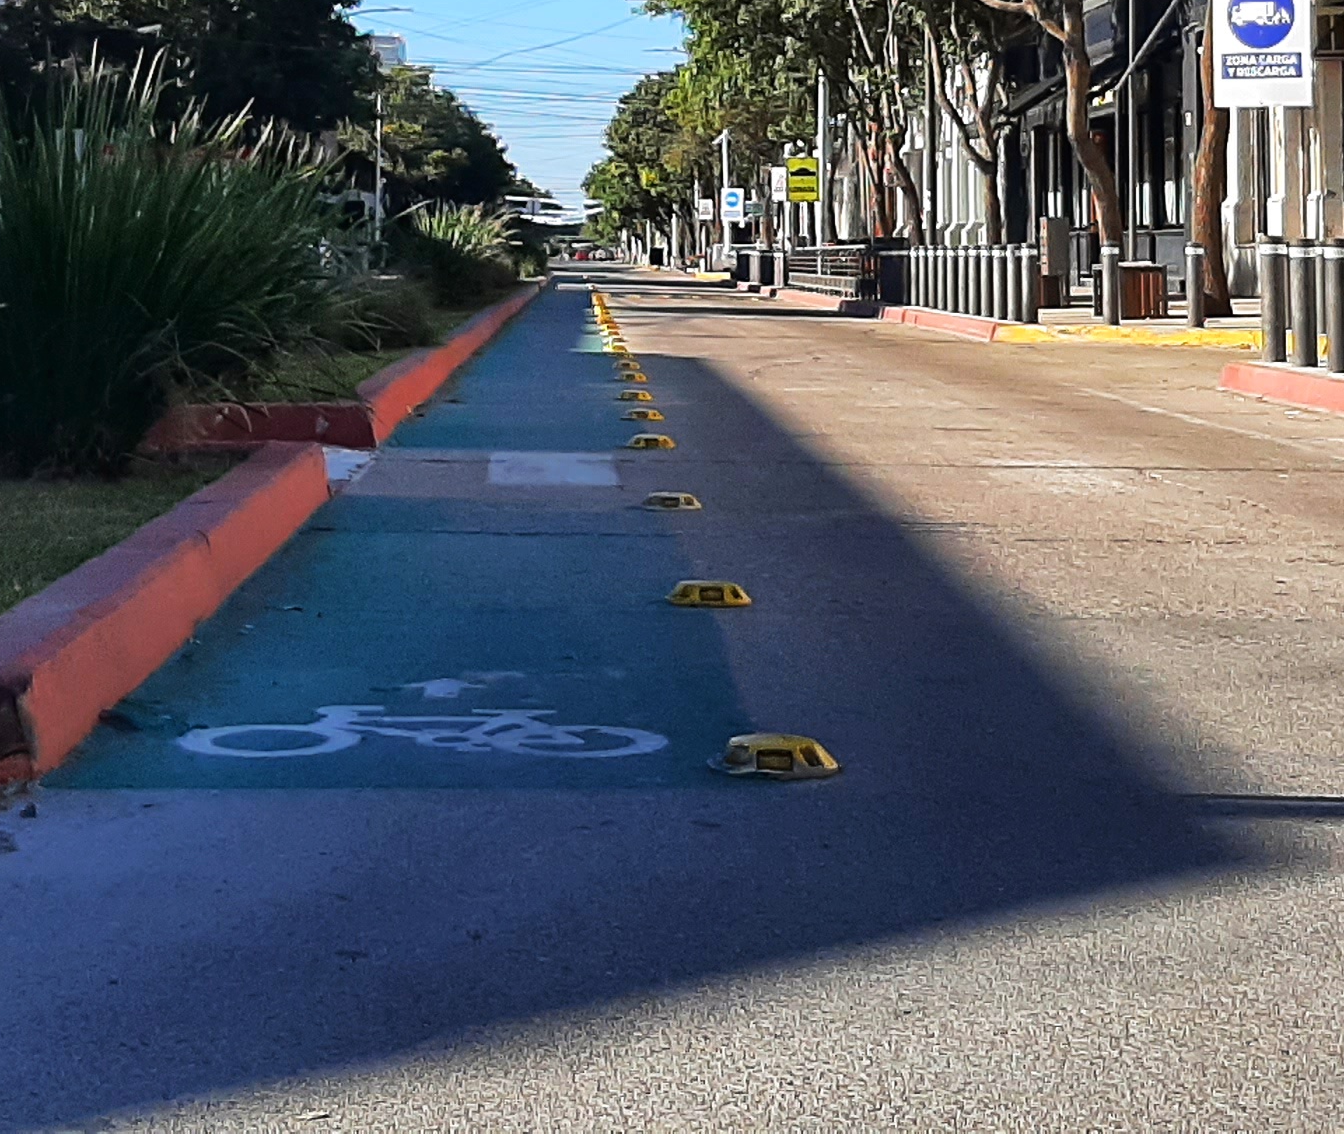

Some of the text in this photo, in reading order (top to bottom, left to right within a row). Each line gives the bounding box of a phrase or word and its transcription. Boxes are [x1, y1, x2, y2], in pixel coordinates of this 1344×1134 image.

[1225, 53, 1298, 66] ZONA CARGA
[1226, 67, 1236, 77] Y
